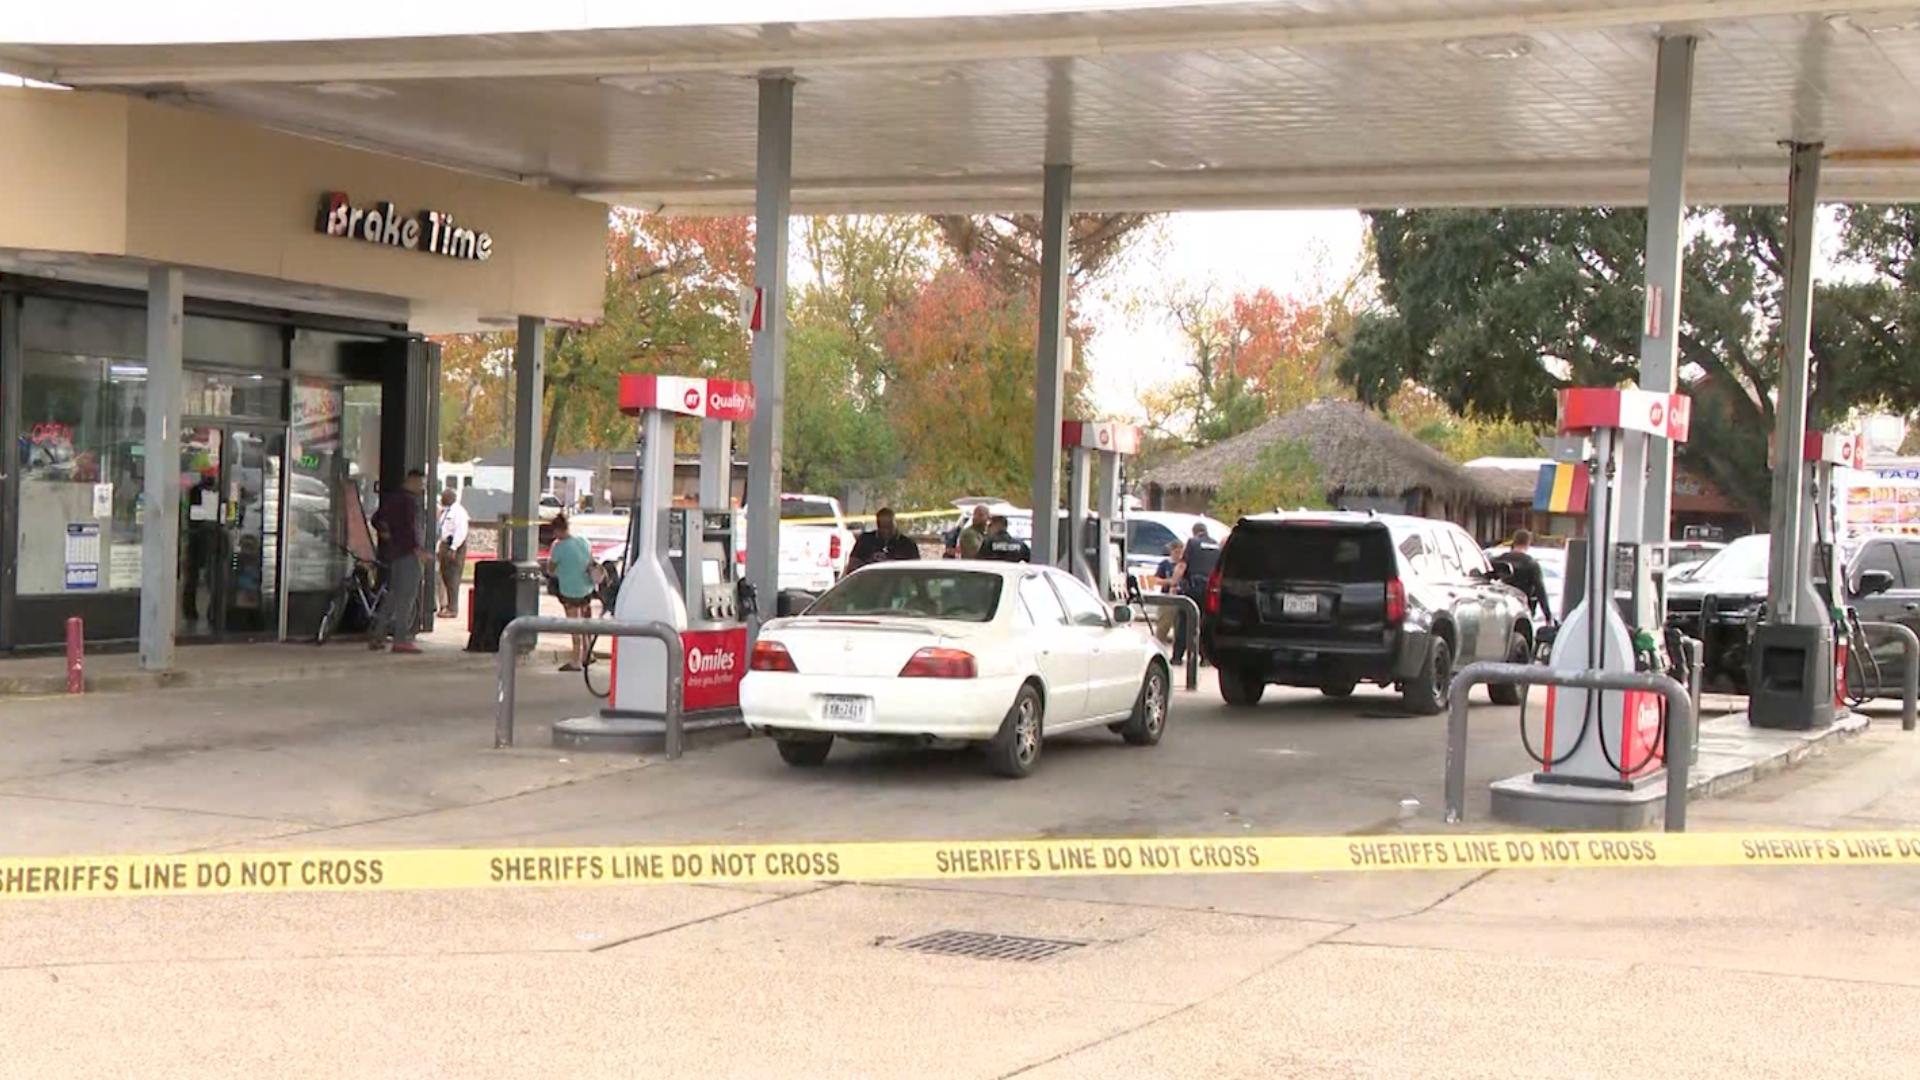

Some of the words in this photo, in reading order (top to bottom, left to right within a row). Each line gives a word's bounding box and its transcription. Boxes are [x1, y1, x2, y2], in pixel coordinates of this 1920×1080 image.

[319, 191, 420, 249] Brake
[425, 210, 493, 261] Time
[710, 393, 745, 412] Quality
[936, 849, 1041, 872] SHERIFFS
[1048, 847, 1097, 870] LINE
[1103, 847, 1131, 869] DO
[1139, 846, 1182, 868] NOT
[1189, 845, 1259, 867] CROSS
[1350, 842, 1448, 865] SHERIFFS
[1453, 842, 1501, 863] LINE
[1506, 841, 1535, 862] DO
[1540, 841, 1581, 861] NOT
[1589, 840, 1656, 860] CROSS
[1742, 839, 1840, 859] SHERIFFS
[1844, 838, 1892, 858] LINE
[128, 863, 187, 890] LINE
[198, 862, 231, 887] DO
[241, 861, 292, 886] NOT
[301, 859, 383, 884] CROSS
[491, 856, 603, 880] SHERIFFS
[612, 855, 663, 878] LINE
[673, 854, 702, 876] DO
[711, 853, 757, 875] NOT
[765, 852, 839, 875] CROSS
